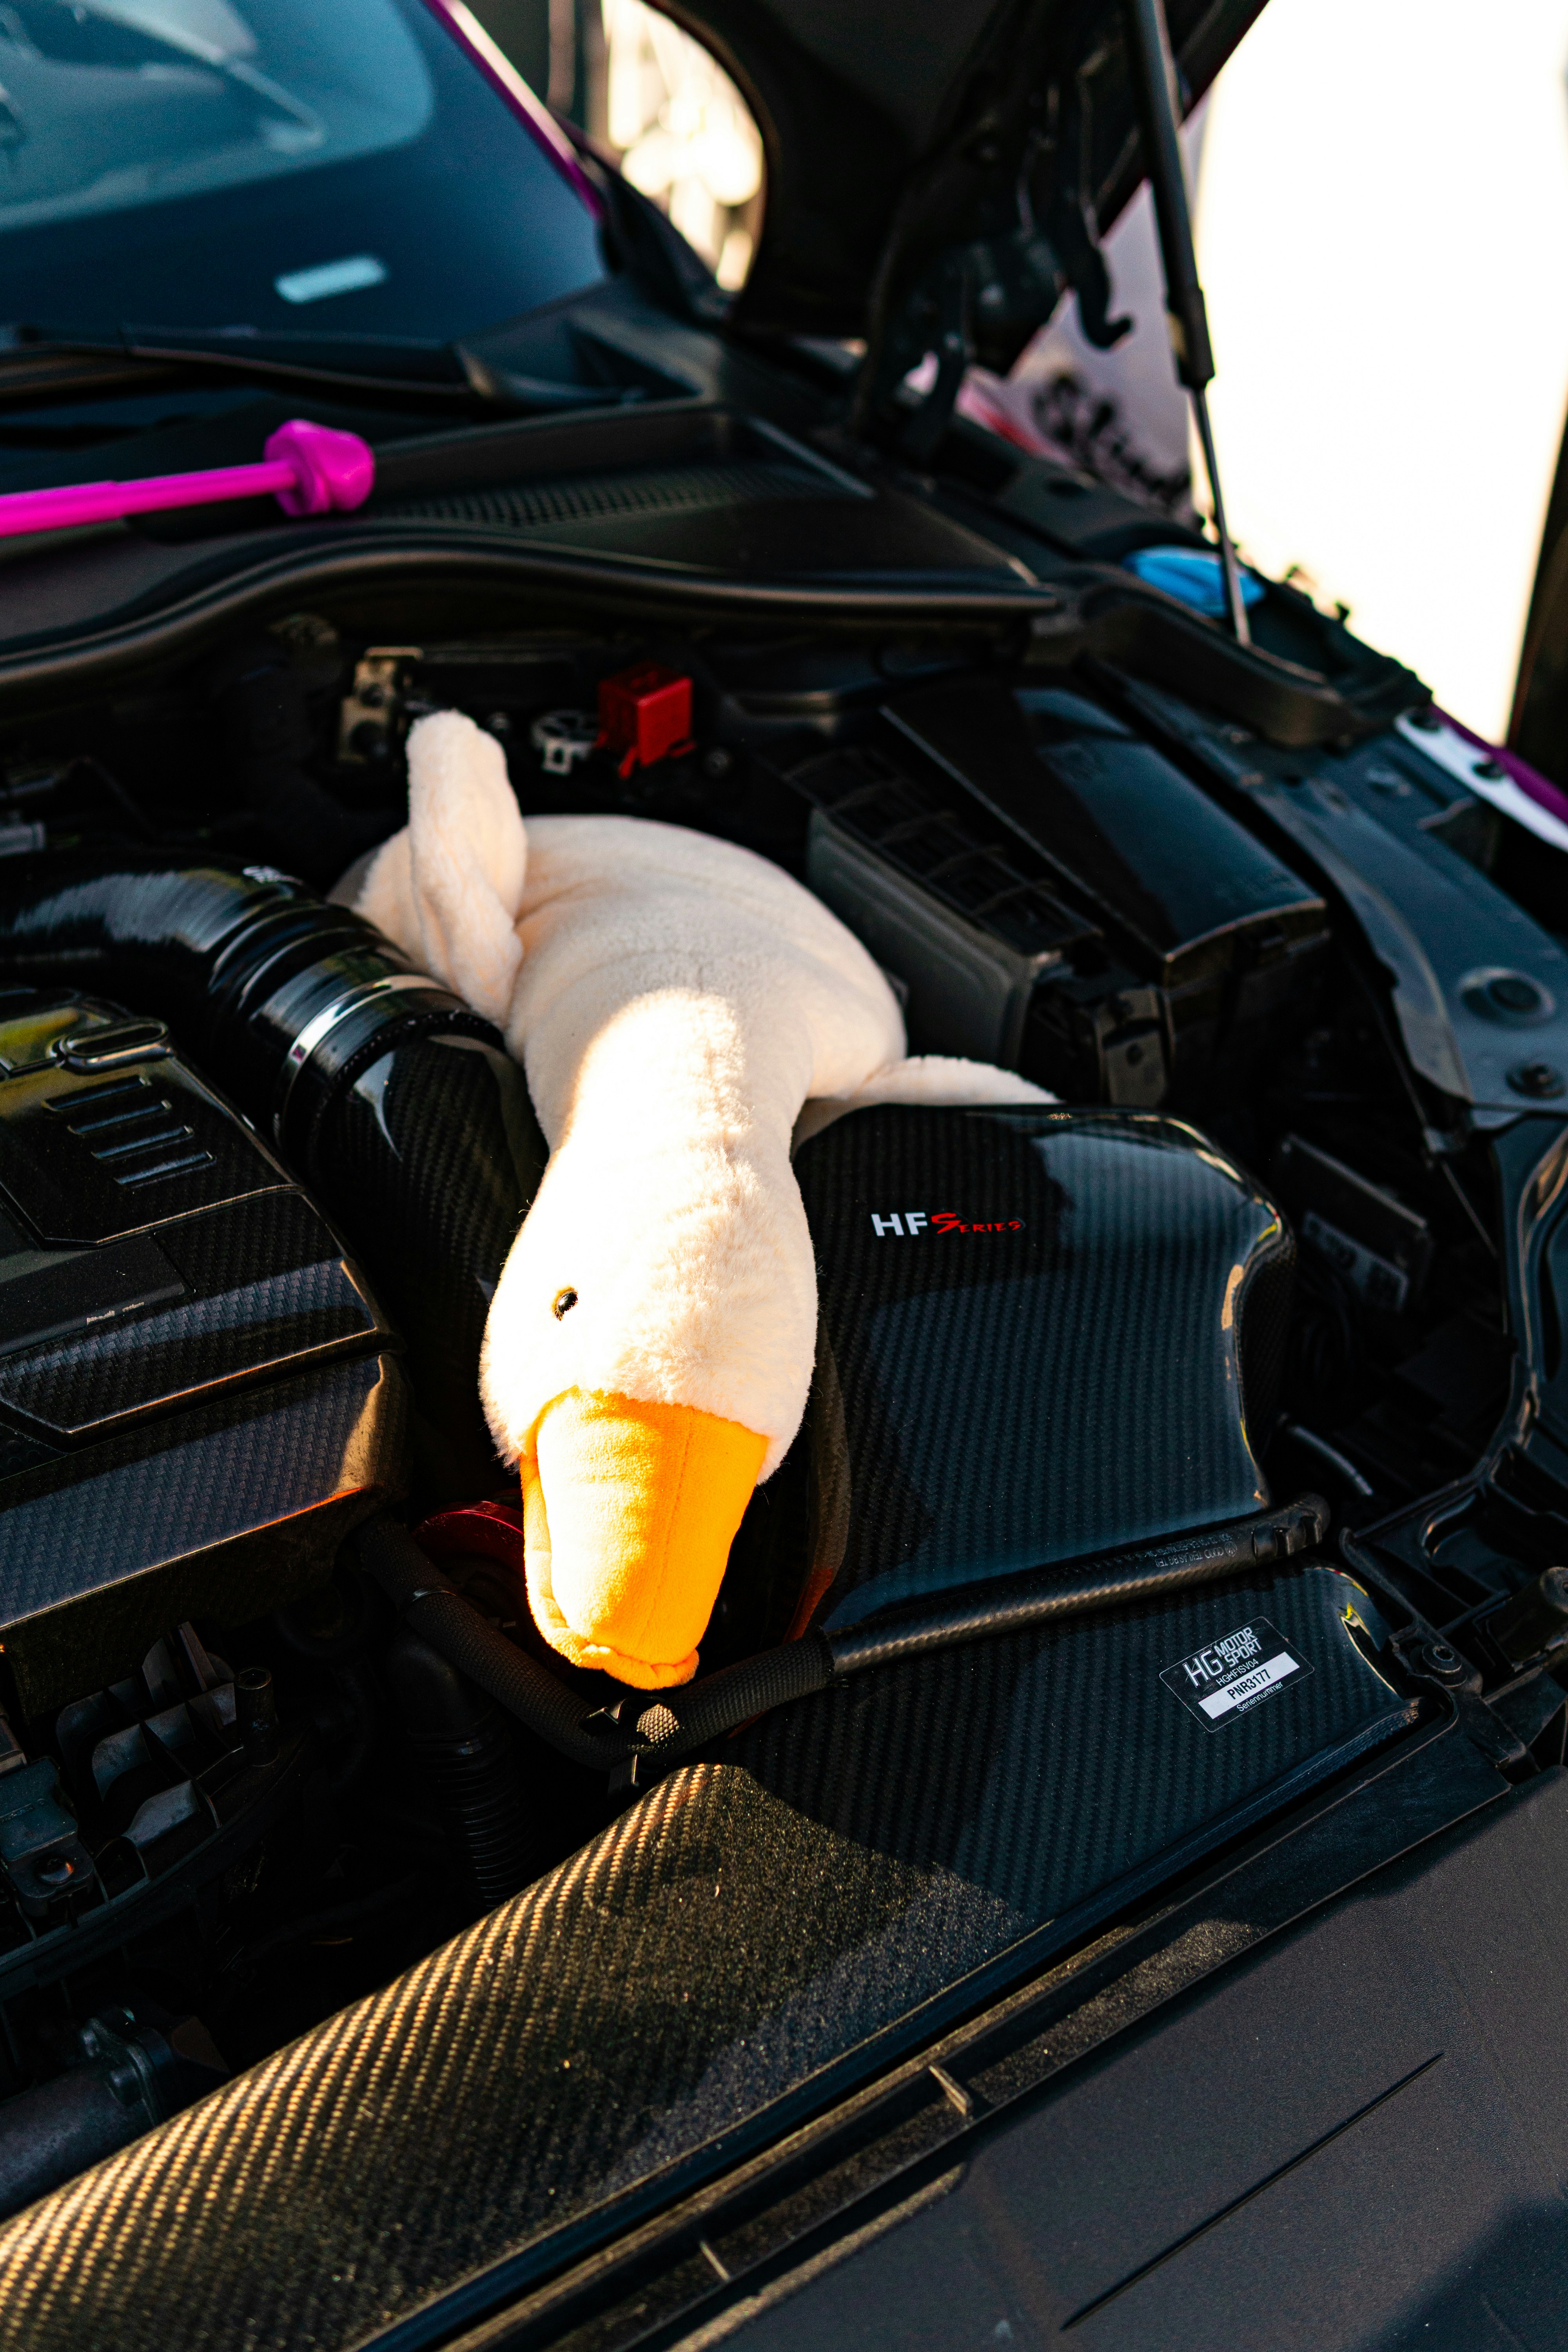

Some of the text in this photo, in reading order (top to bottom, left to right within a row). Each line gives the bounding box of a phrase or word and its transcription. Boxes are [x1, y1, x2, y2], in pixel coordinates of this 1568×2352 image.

[871, 1212, 927, 1236] HF
[1214, 1627, 1256, 1658] MOTOR
[1224, 1638, 1263, 1668] SPORT
[1182, 1648, 1224, 1688] HG
[1216, 1658, 1259, 1686] HGHFISV04
[1227, 1669, 1271, 1700] PNR3177
[1236, 1681, 1283, 1712] Seriennummer
